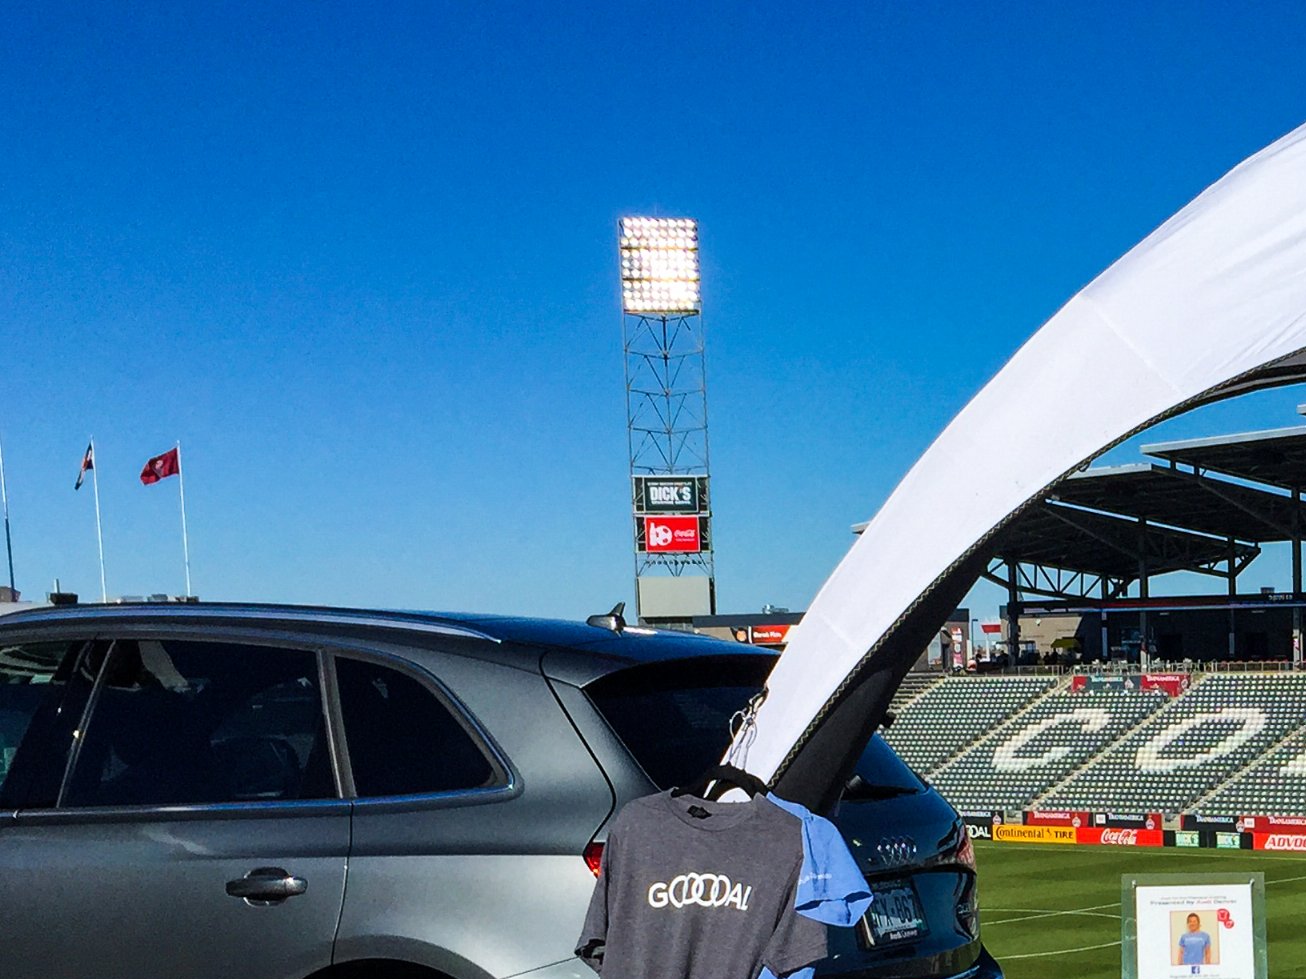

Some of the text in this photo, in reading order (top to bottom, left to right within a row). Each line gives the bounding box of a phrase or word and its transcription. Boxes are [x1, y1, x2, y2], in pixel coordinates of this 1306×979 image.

[649, 486, 691, 501] DICK'S
[996, 826, 1074, 839] Continental TIRE
